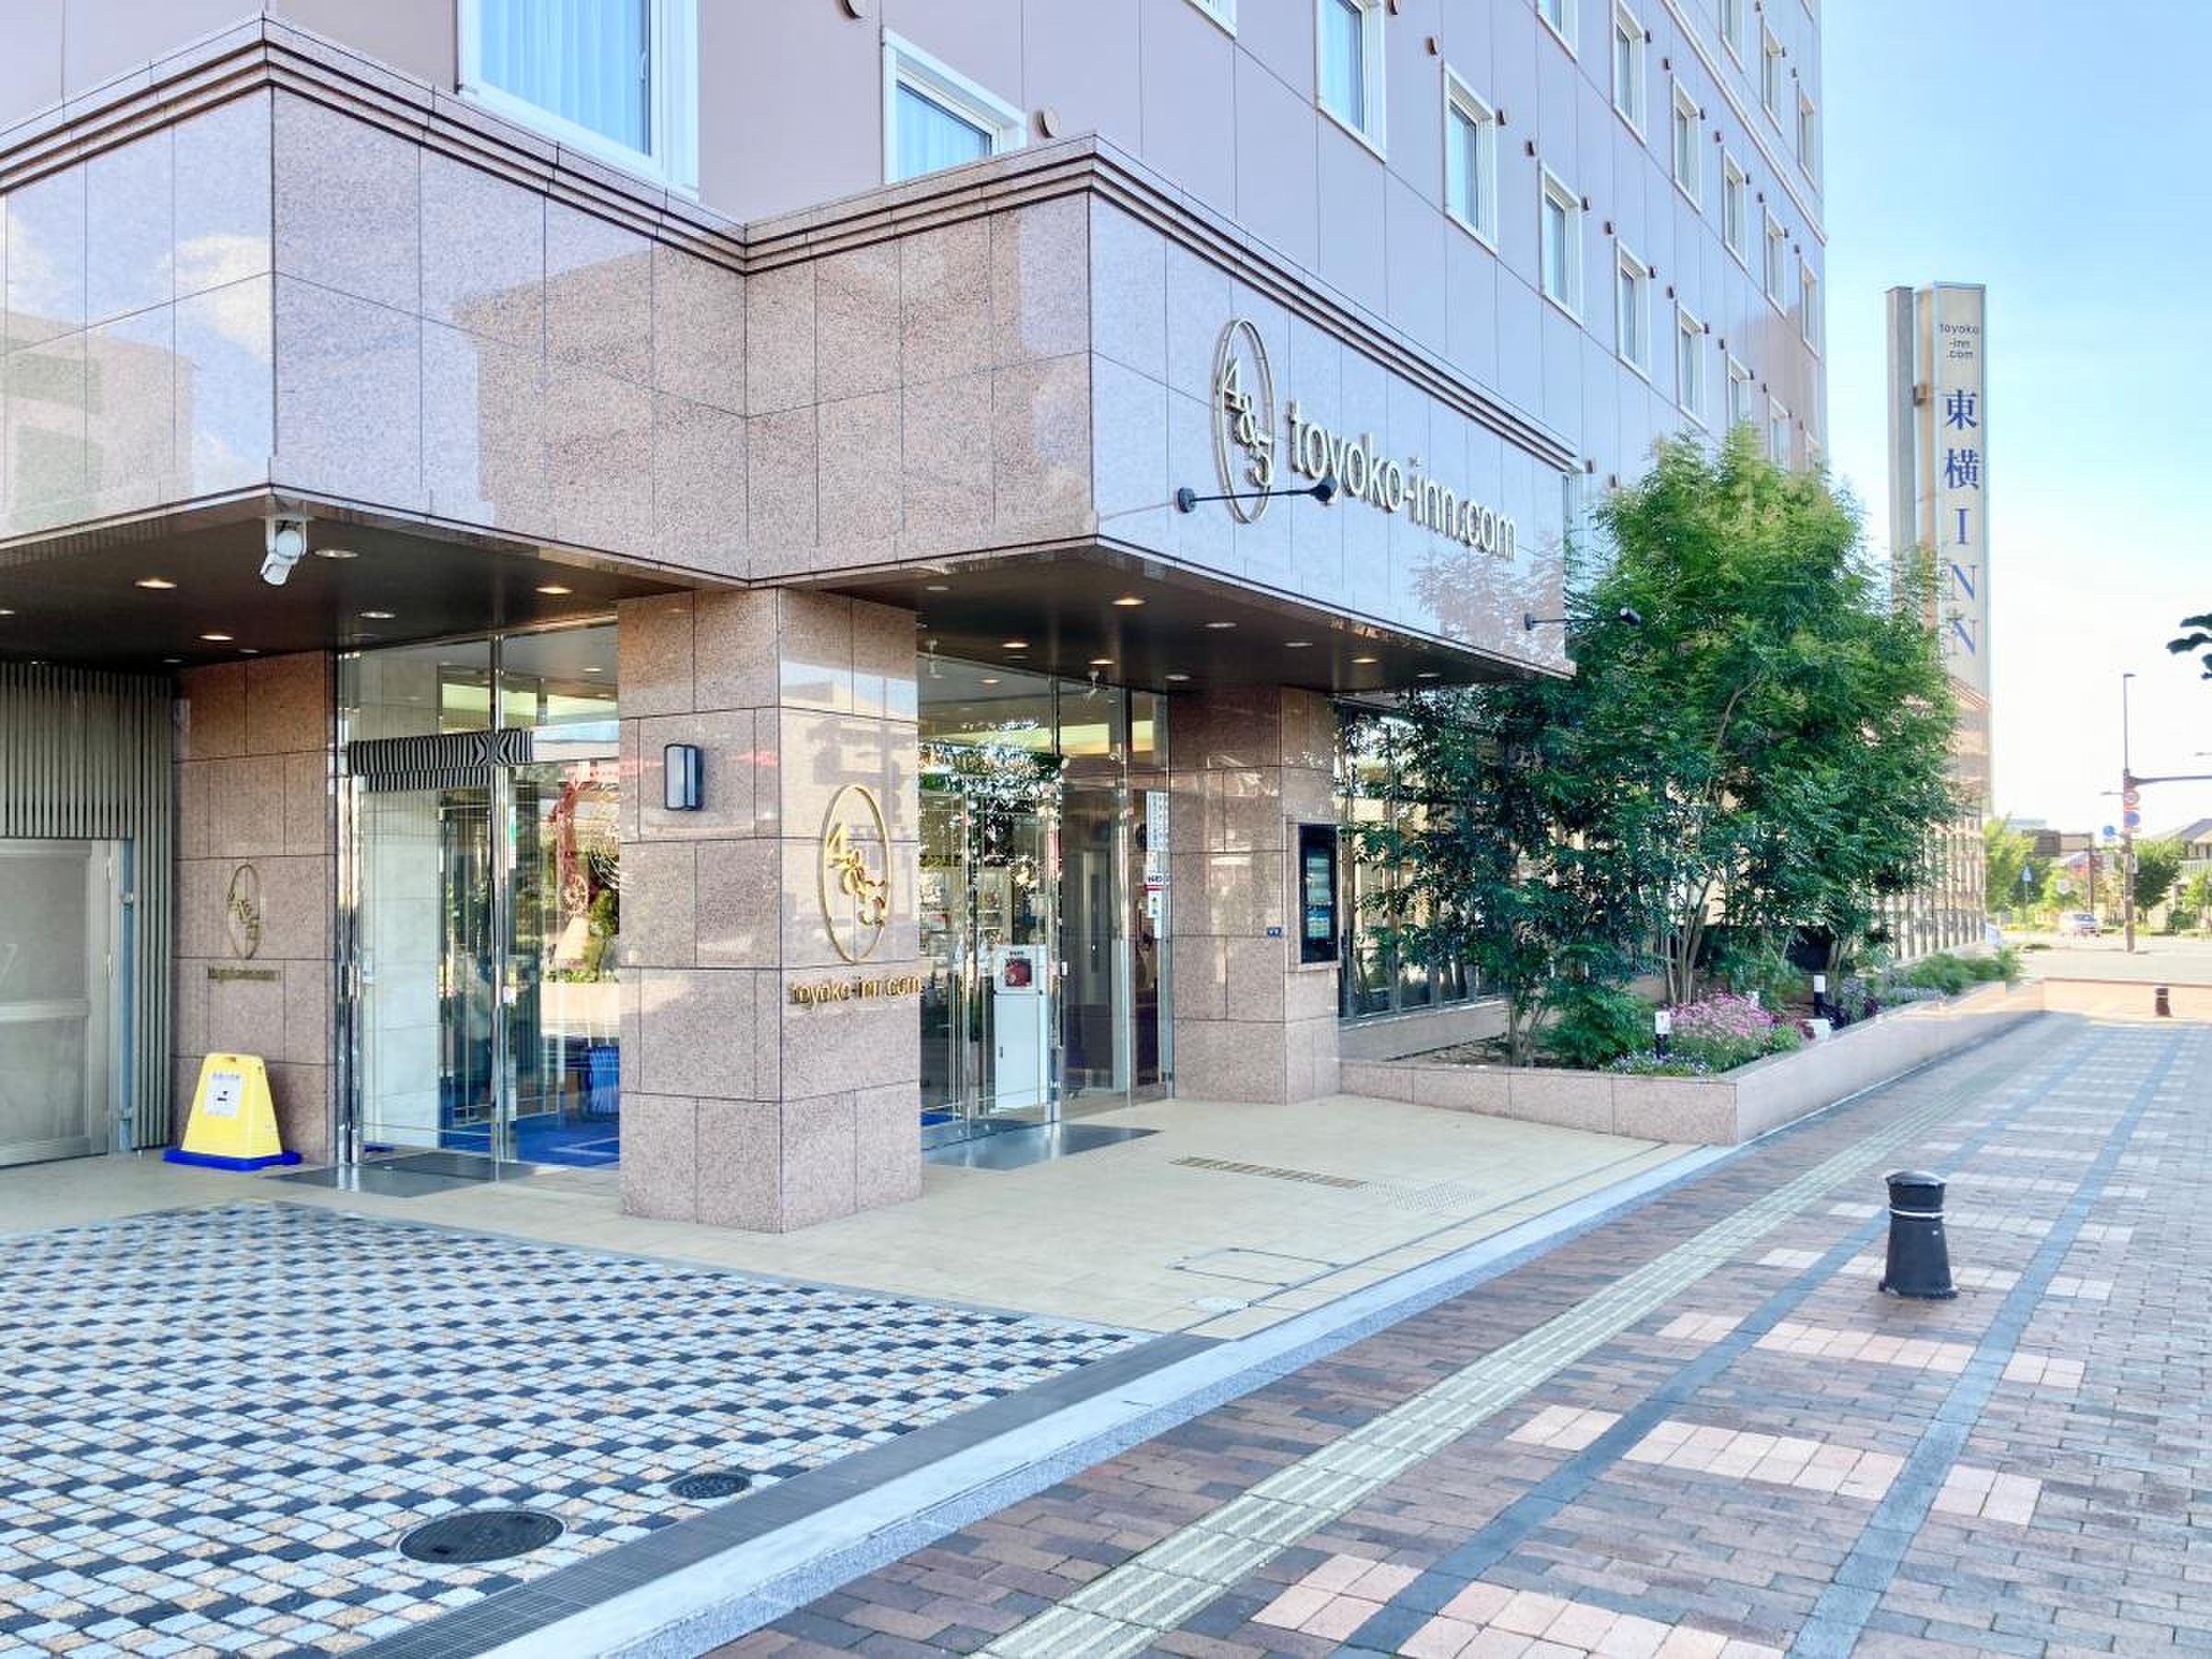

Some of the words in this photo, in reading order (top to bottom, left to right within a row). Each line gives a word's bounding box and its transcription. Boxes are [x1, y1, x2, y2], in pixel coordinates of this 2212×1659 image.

[1939, 324, 1980, 335] toyoko
[1946, 349, 1973, 359] .com
[1287, 399, 1518, 561] toyoko-inn.com
